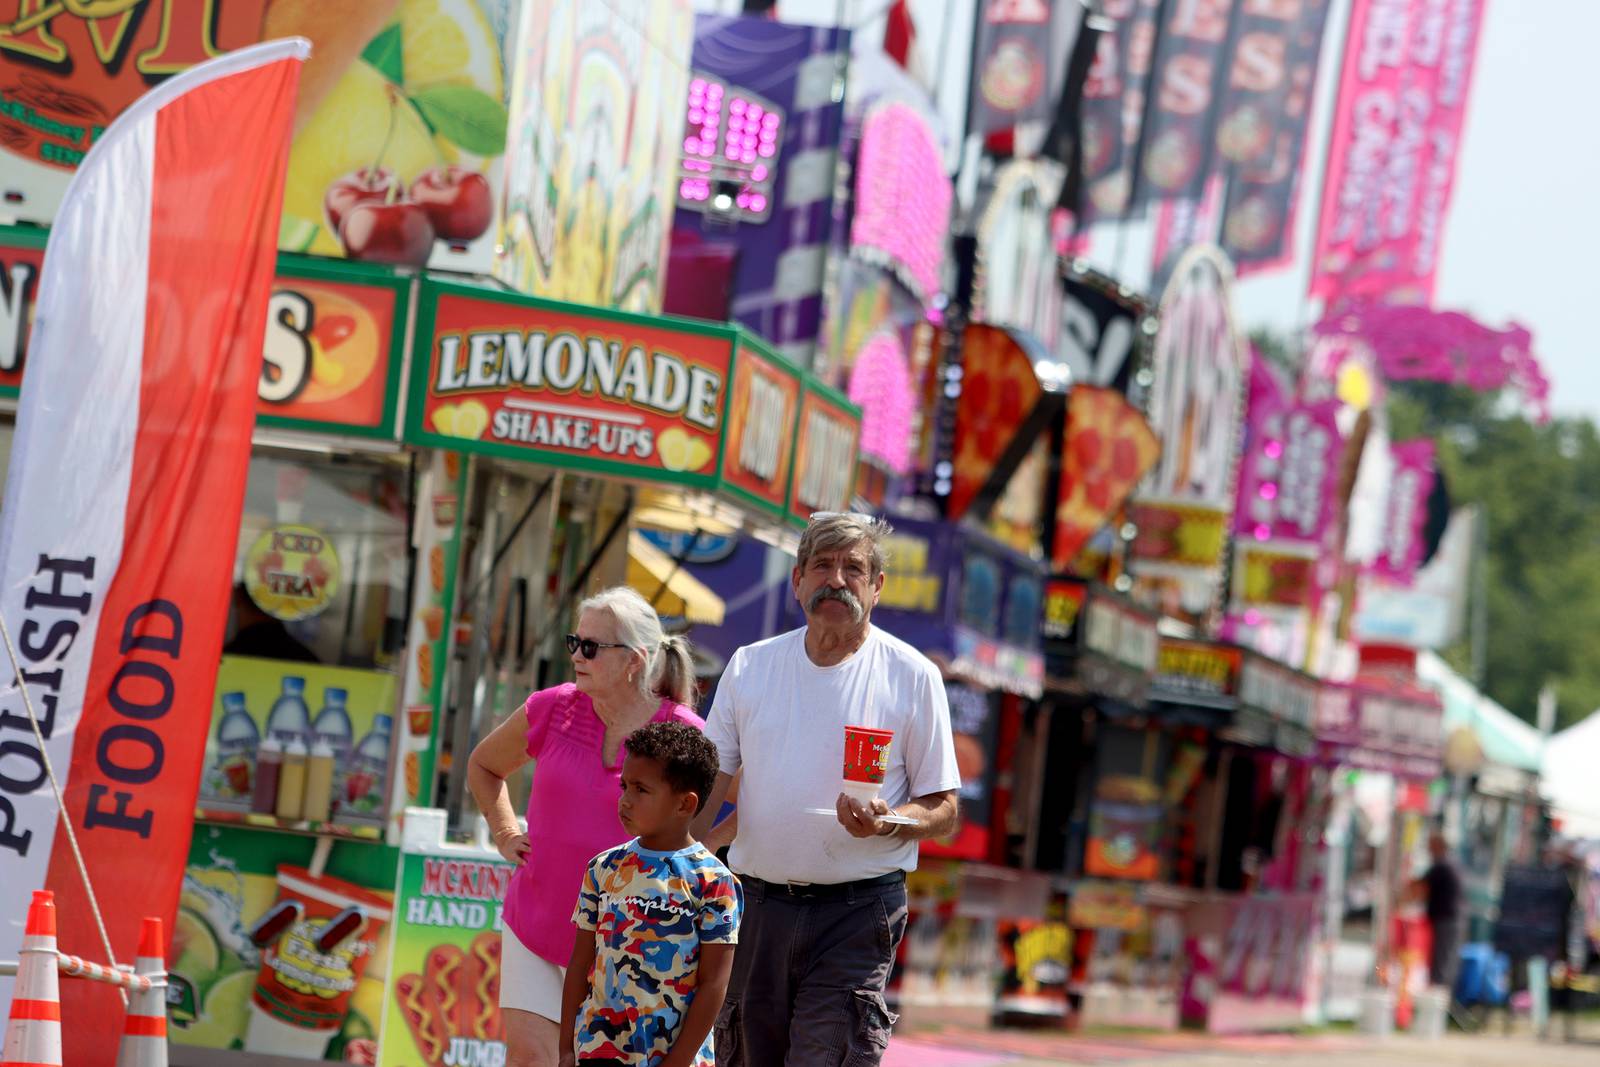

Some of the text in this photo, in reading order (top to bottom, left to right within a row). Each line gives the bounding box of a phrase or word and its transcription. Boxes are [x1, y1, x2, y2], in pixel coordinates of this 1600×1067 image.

[437, 331, 722, 429] LEMONADE
[491, 408, 654, 459] SHAKE-UPS
[267, 572, 316, 598] TEA
[83, 598, 184, 840] FOOD
[406, 897, 488, 929] HAND
